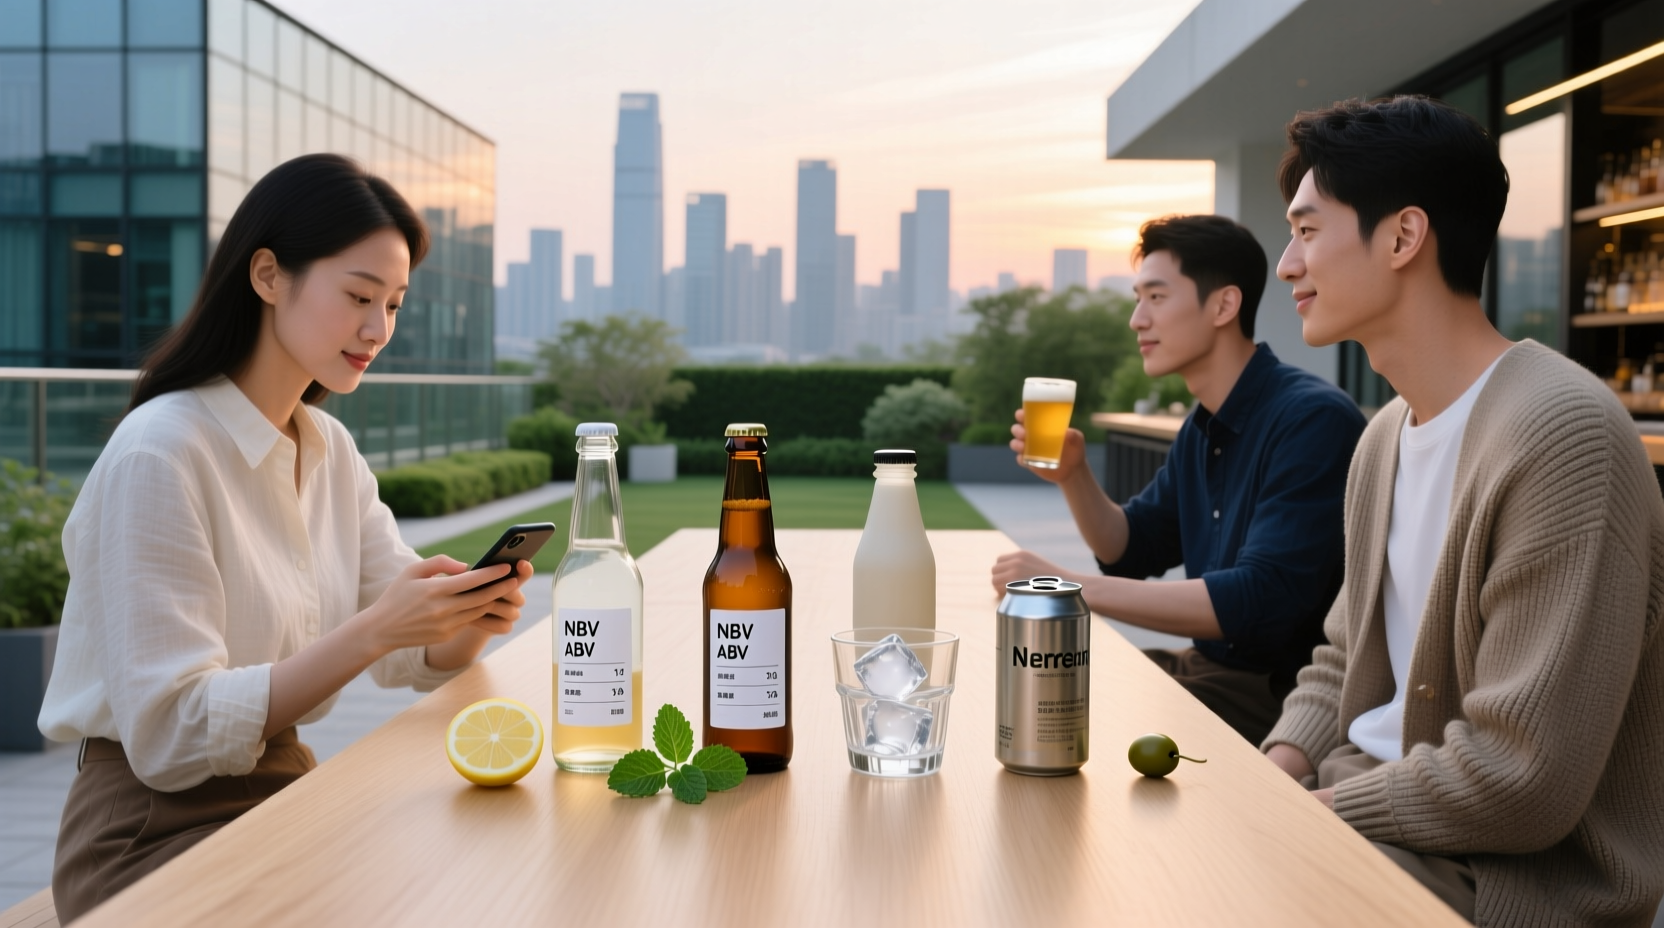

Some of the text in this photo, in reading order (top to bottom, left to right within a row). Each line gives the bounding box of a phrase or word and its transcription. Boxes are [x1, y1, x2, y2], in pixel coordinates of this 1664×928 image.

[564, 620, 600, 637] NBV
[717, 622, 754, 640] NBV
[564, 641, 595, 658] ABV
[717, 644, 749, 660] ABV
